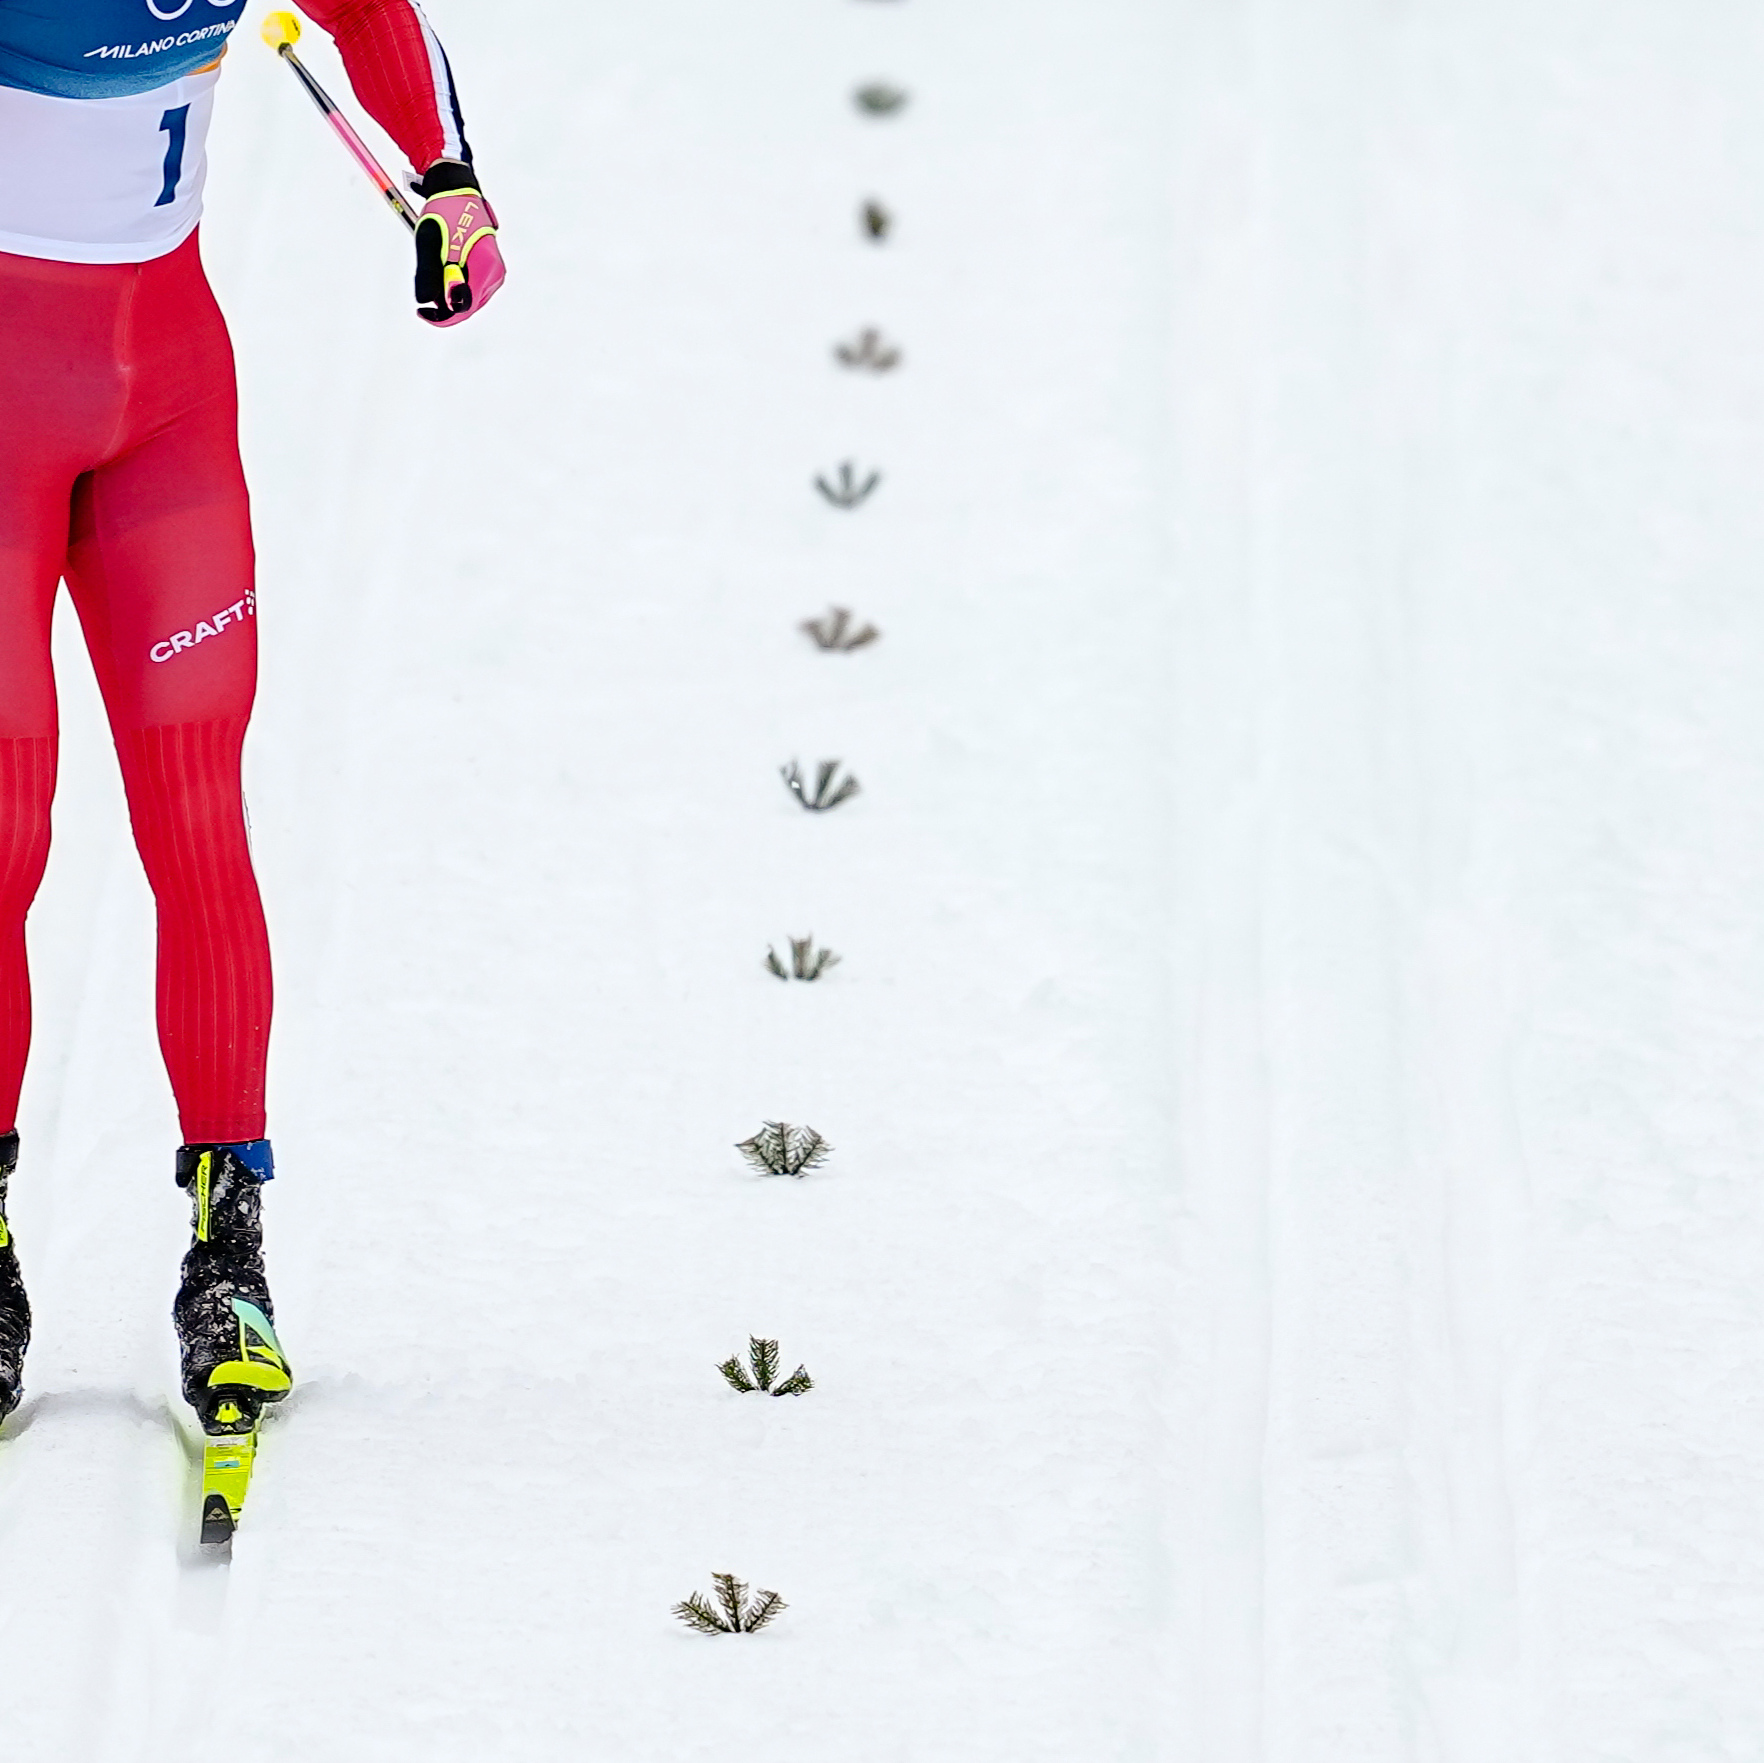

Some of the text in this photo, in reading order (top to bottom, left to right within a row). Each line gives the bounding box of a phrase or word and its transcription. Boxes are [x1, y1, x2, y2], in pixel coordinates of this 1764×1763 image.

[83, 19, 237, 59] MILANO CORTINA
[153, 102, 191, 208] 1
[450, 201, 479, 251] LEKI
[149, 599, 245, 664] CRAFT
